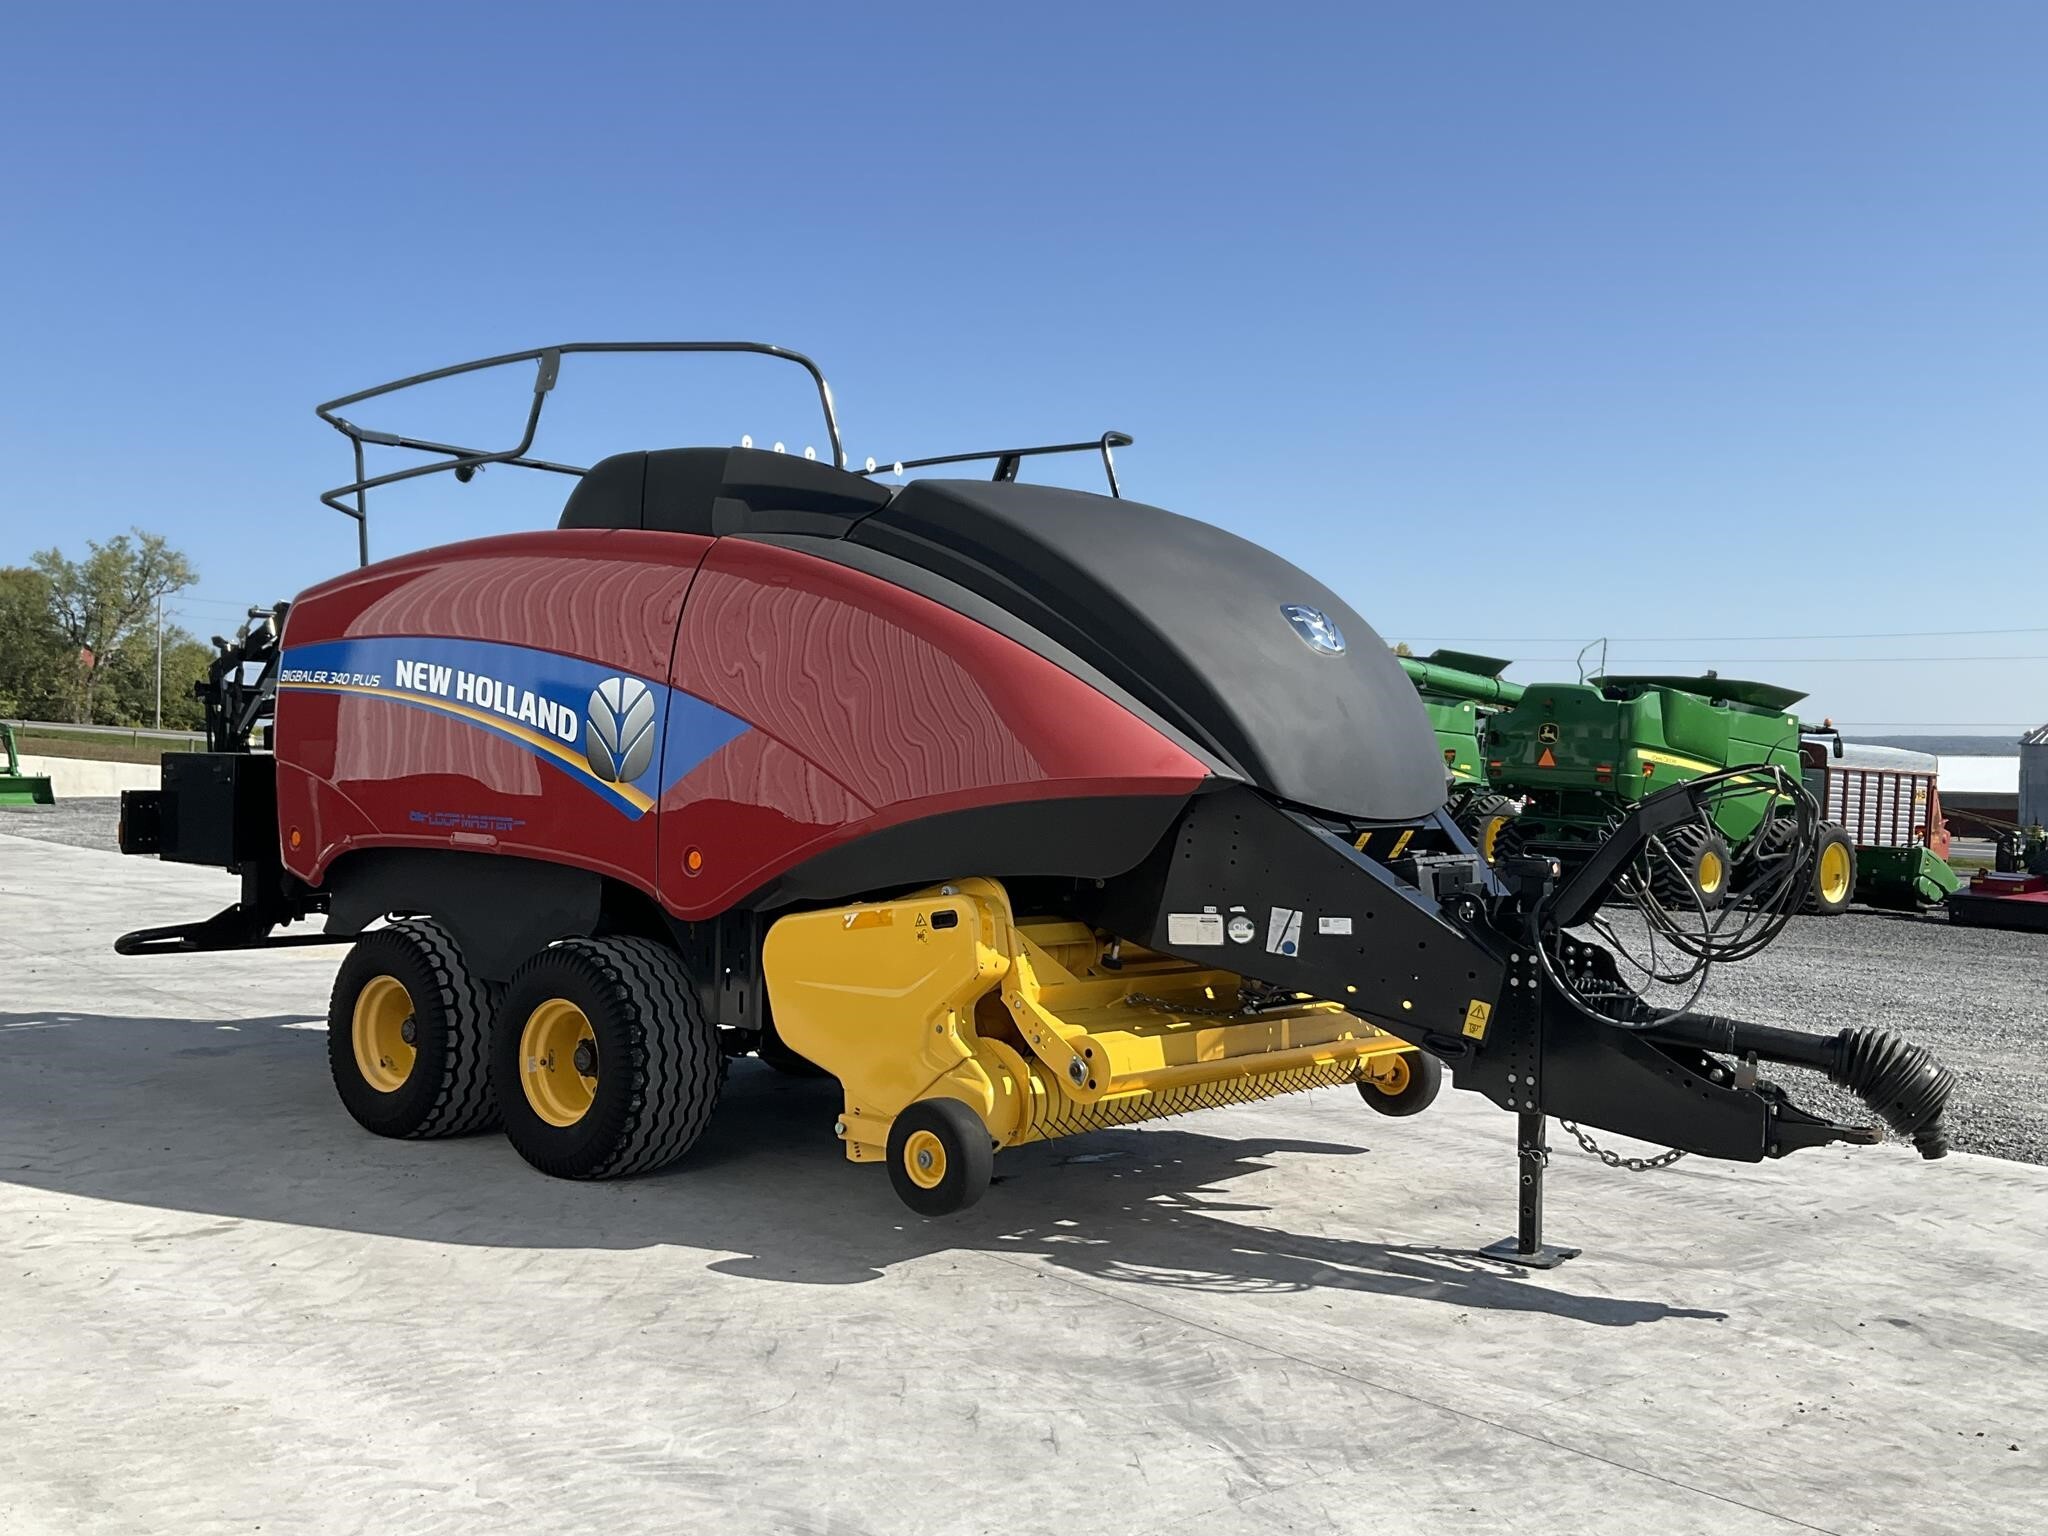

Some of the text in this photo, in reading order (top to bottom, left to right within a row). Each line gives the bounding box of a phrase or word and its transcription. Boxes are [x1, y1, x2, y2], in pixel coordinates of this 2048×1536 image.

[281, 669, 381, 687] BIGBALER 340 PLUS
[395, 659, 578, 743] NEW HOLLAND
